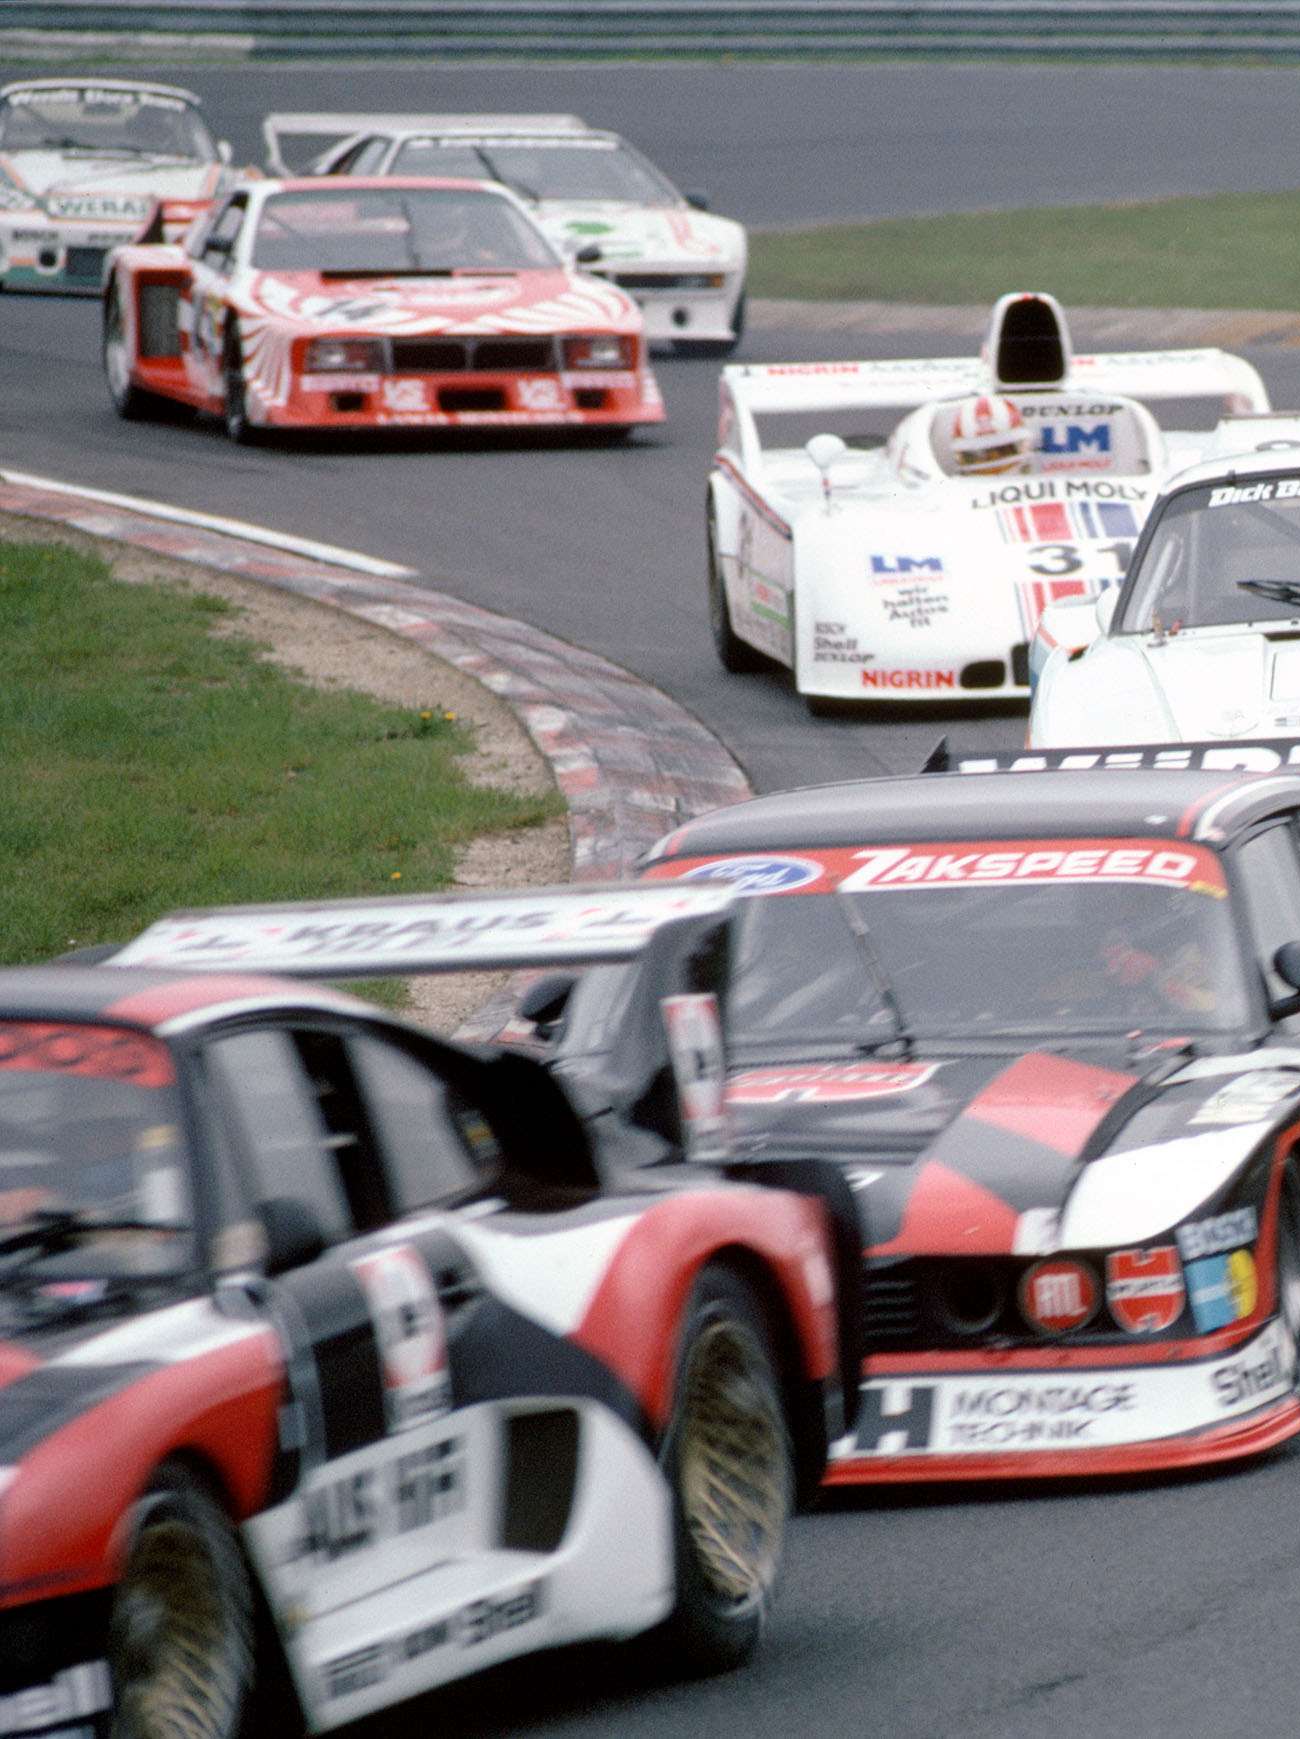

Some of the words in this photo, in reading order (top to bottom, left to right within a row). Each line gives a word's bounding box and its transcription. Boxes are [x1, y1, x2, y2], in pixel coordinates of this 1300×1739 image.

[1022, 403, 1124, 418] DUNLOP
[1040, 423, 1112, 454] LM
[972, 482, 1056, 509] LIQUI
[1066, 481, 1148, 501] MOLY
[1208, 483, 1273, 509] Dick
[870, 556, 944, 573] LM
[1028, 541, 1132, 576] 31
[814, 636, 858, 650] Shell
[861, 669, 955, 689] NIGRIN
[838, 848, 1197, 892] ZAKSPEED
[1211, 1345, 1284, 1406] Shel
[952, 1383, 1136, 1417] MONTAGE
[948, 1418, 1097, 1447] TECHNIK
